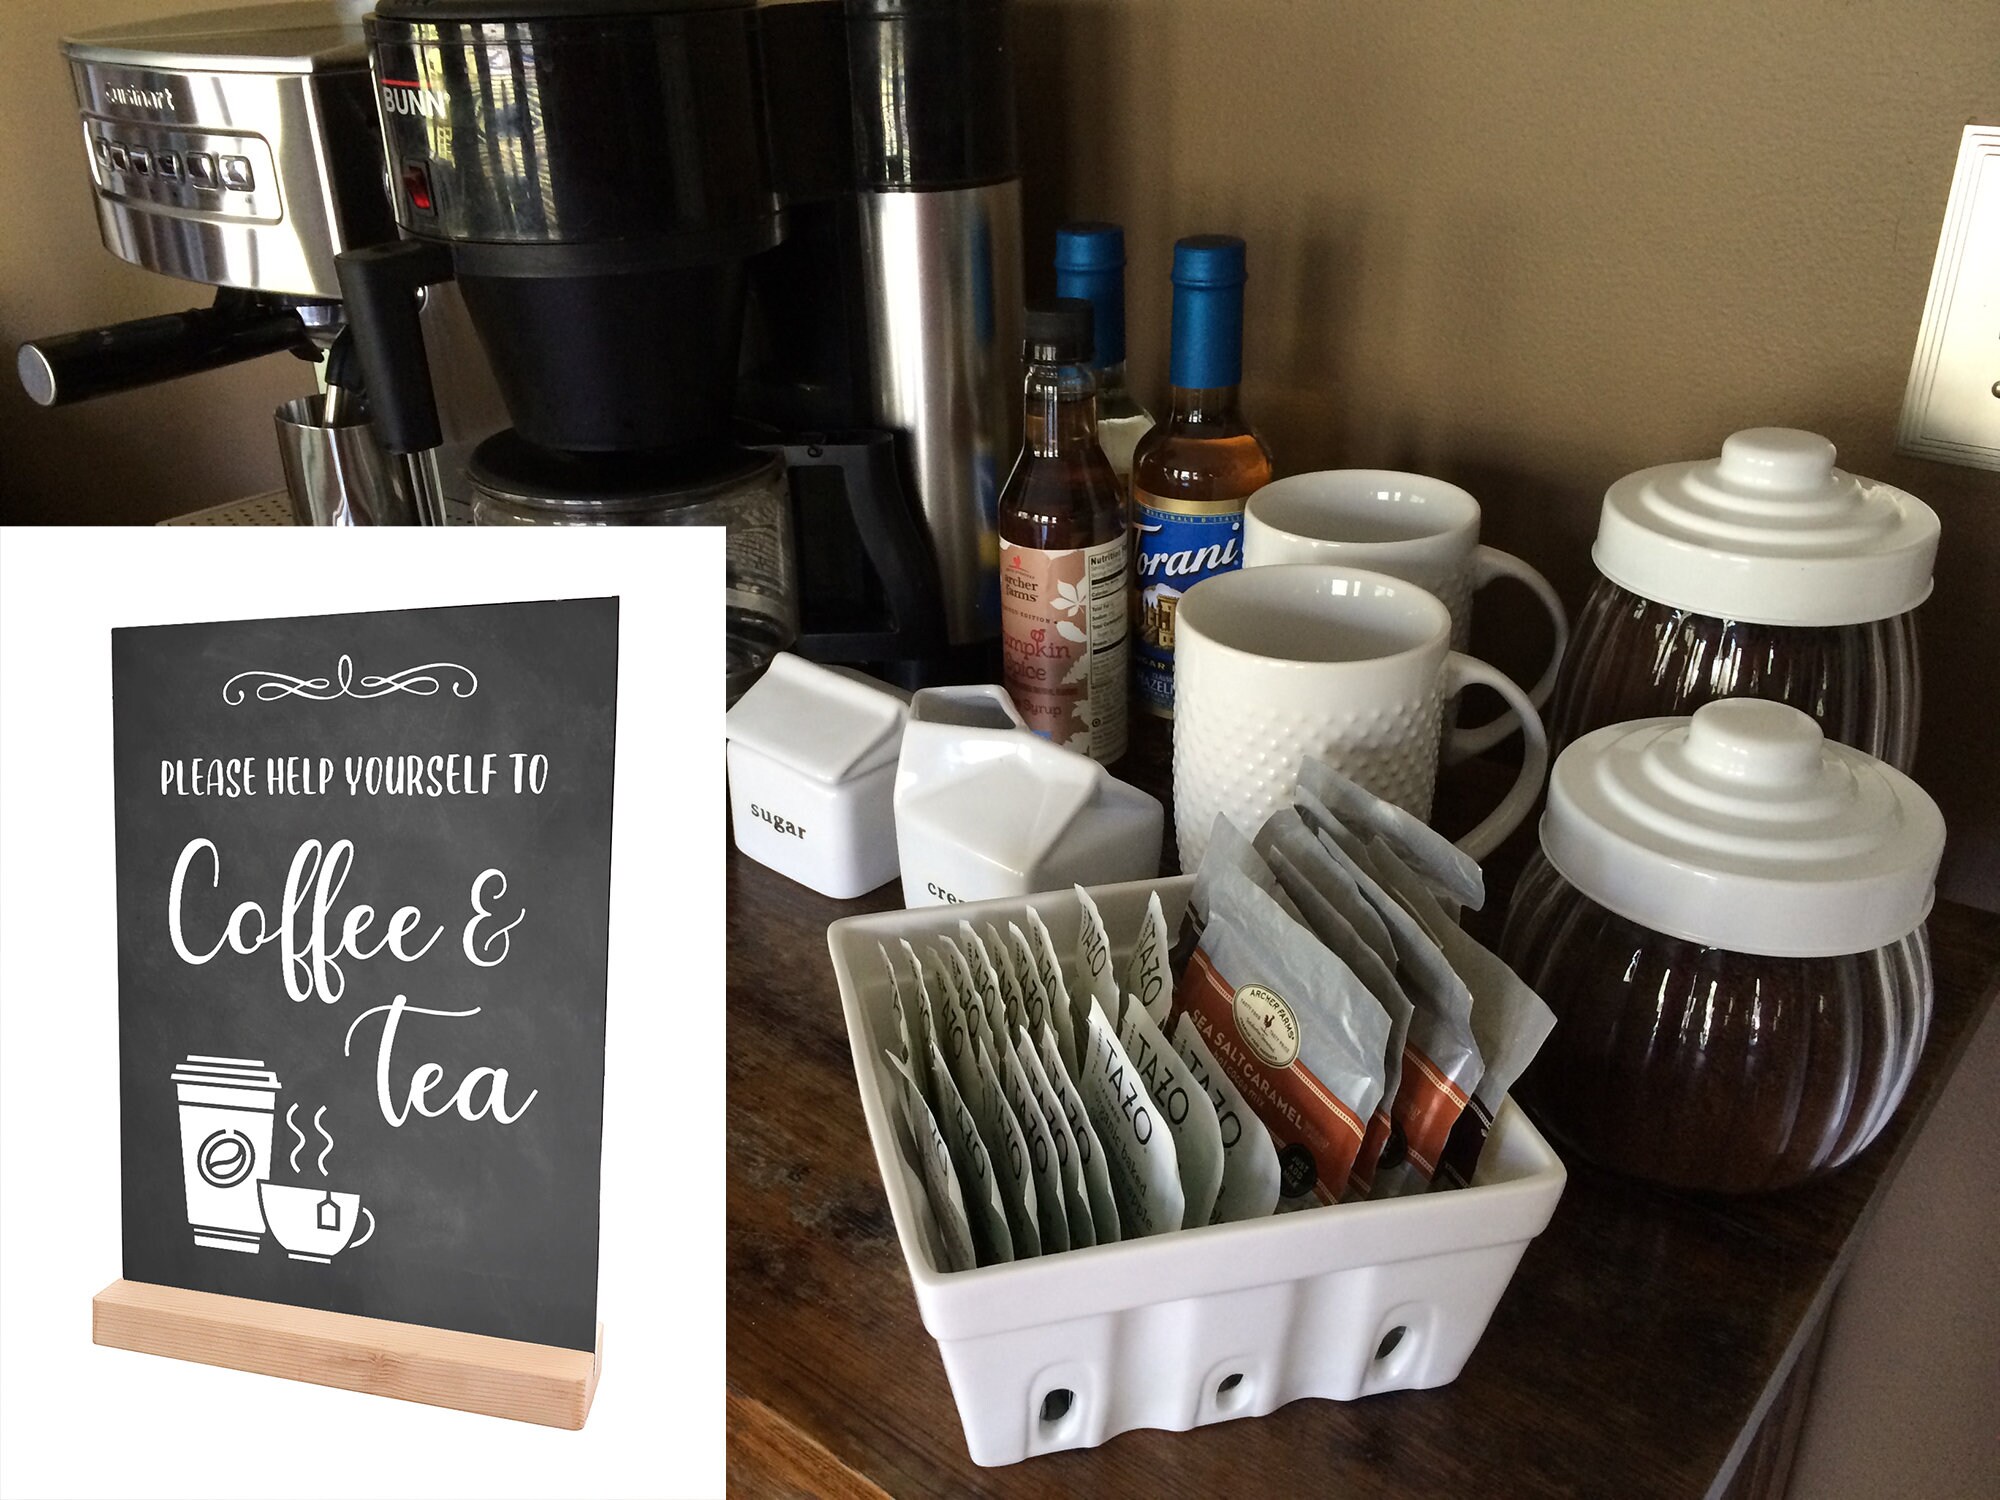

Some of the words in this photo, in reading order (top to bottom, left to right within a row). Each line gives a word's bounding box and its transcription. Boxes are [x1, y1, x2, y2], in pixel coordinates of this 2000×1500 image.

[382, 86, 447, 119] BUNN
[160, 757, 256, 798] PLEASE
[267, 756, 334, 797] HELP
[344, 754, 498, 798] YOURSELF
[508, 753, 549, 795] TO
[751, 803, 807, 839] sugar
[168, 837, 445, 1005] Coffee
[462, 868, 526, 968] &
[1081, 909, 1107, 977] TAZO
[1139, 922, 1163, 1007] TAZO
[1250, 989, 1280, 1010] ARCHER
[1277, 1009, 1295, 1040] FARMS
[344, 993, 539, 1128] Tea
[1105, 1039, 1153, 1146] TAZO
[1137, 1033, 1190, 1126] TAZO
[1190, 1050, 1242, 1149] TAZO
[1192, 1009, 1213, 1038] SEA
[1214, 1032, 1245, 1066] SALT
[1243, 1062, 1304, 1130] CARAMEL
